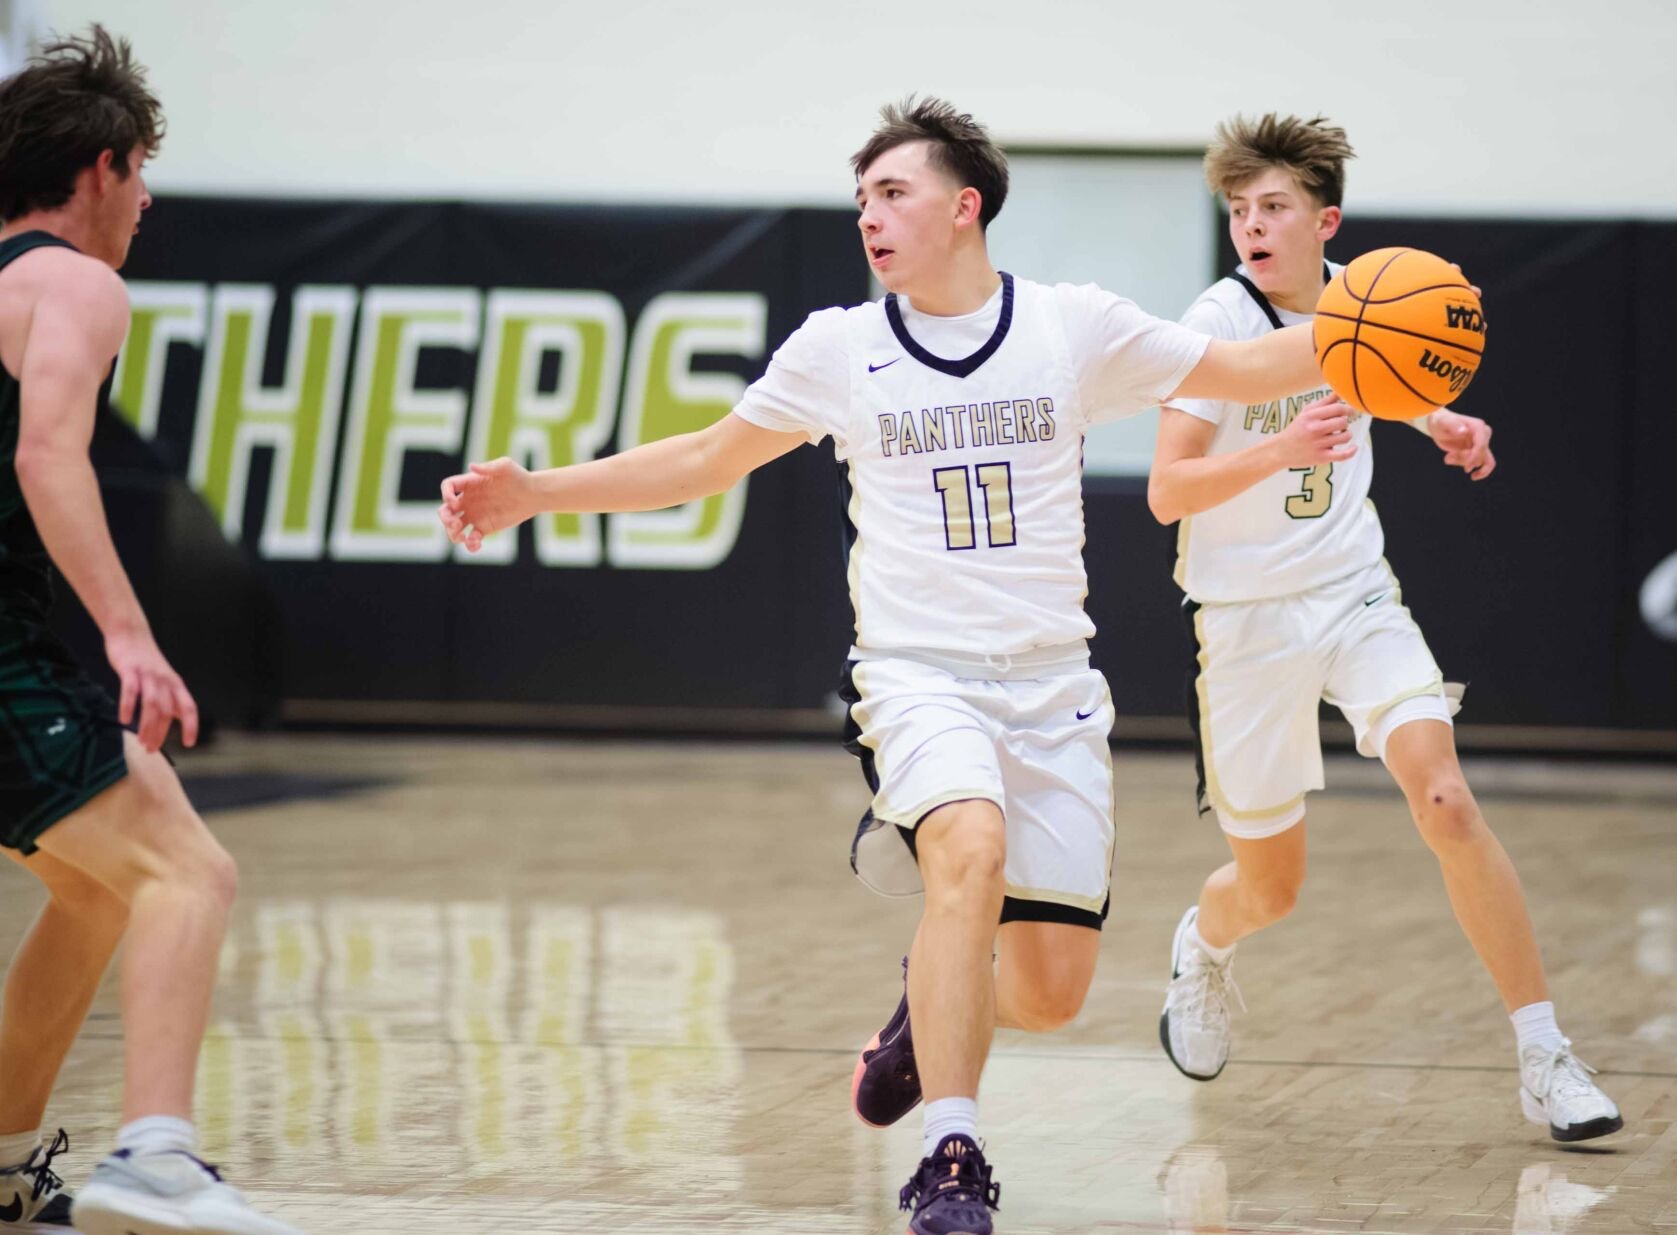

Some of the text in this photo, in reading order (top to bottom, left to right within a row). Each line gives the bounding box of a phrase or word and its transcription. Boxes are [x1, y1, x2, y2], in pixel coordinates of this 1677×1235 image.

[1446, 304, 1484, 334] CAA
[878, 397, 1056, 457] PANTHERS
[932, 461, 1017, 551] 11
[1285, 461, 1334, 519] 3
